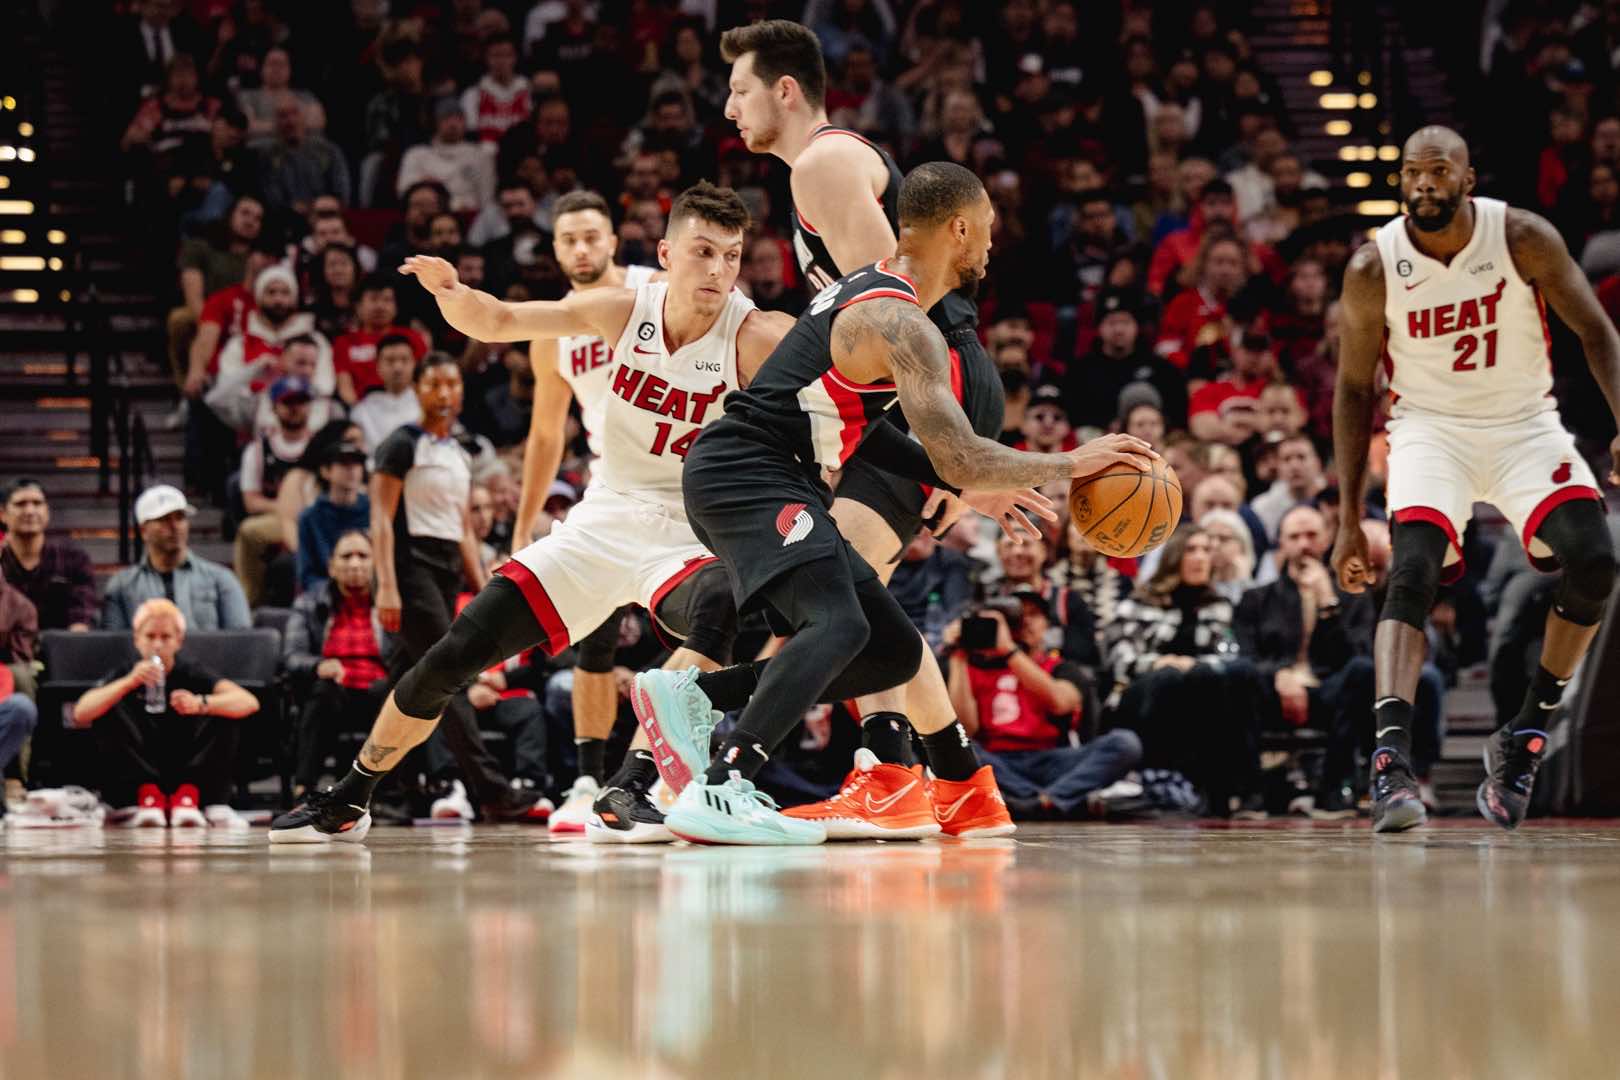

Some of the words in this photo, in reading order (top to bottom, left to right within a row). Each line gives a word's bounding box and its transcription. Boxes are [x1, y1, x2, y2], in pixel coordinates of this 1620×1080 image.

[1468, 261, 1494, 275] UKG
[1407, 277, 1506, 339] HEAT
[638, 321, 656, 341] 6
[1452, 328, 1498, 372] 21
[571, 340, 614, 377] HE
[695, 360, 721, 373] UKG
[612, 363, 727, 425] HEAT
[649, 421, 703, 463] 14
